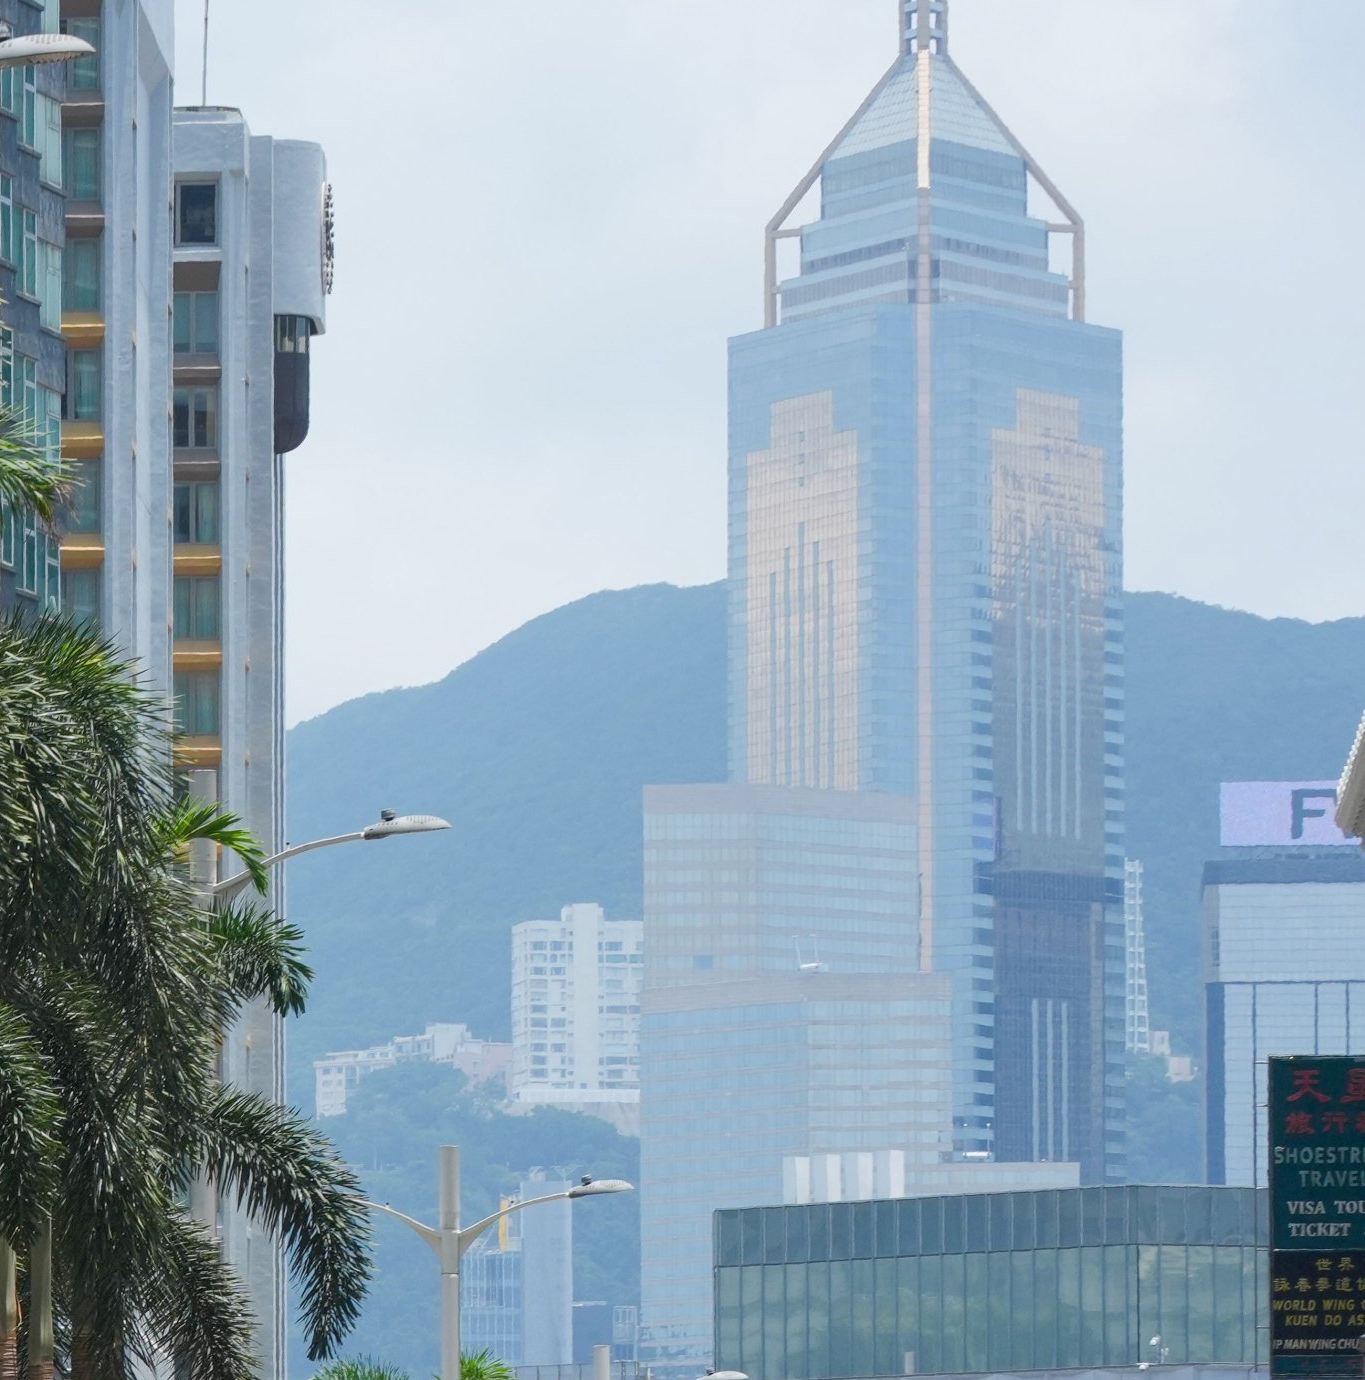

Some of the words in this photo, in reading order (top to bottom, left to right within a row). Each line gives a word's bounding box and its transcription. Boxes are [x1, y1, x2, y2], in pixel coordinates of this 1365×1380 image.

[1287, 1201, 1326, 1215] VISA
[1288, 1222, 1351, 1237] TICKET
[1316, 1257, 1355, 1271] 世界
[1273, 1299, 1316, 1311] WORLD
[1323, 1299, 1355, 1311] WING
[1285, 1314, 1317, 1326] KUEN
[1324, 1314, 1342, 1326] DO
[1284, 1338, 1308, 1350] MAN
[1308, 1338, 1336, 1350] WING
[1338, 1338, 1360, 1350] CHU
